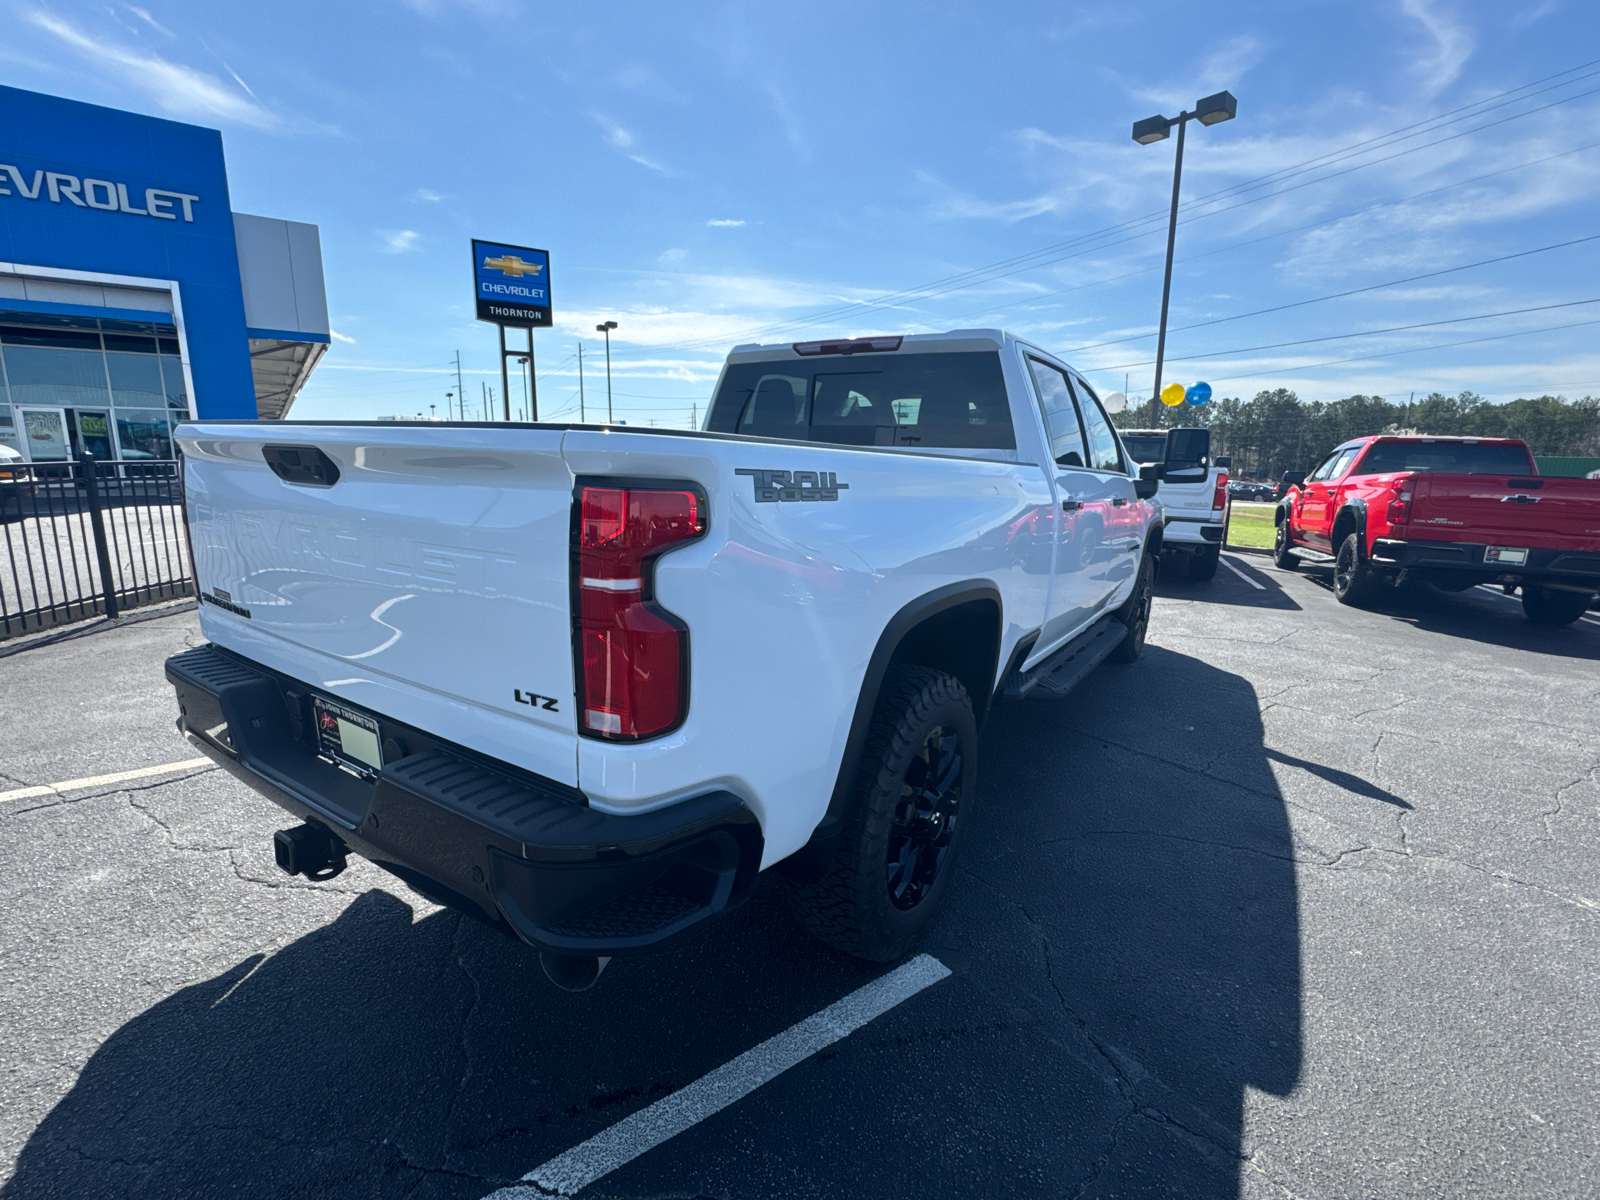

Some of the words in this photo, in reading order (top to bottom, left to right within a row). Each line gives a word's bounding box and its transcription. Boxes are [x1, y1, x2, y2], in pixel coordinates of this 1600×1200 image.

[482, 282, 545, 299] CHEVROLET
[489, 305, 542, 320] THORNTON
[734, 468, 850, 489] TRAIL
[755, 486, 839, 503] BOSS
[325, 702, 341, 715] JOHN
[514, 689, 559, 712] LTZ
